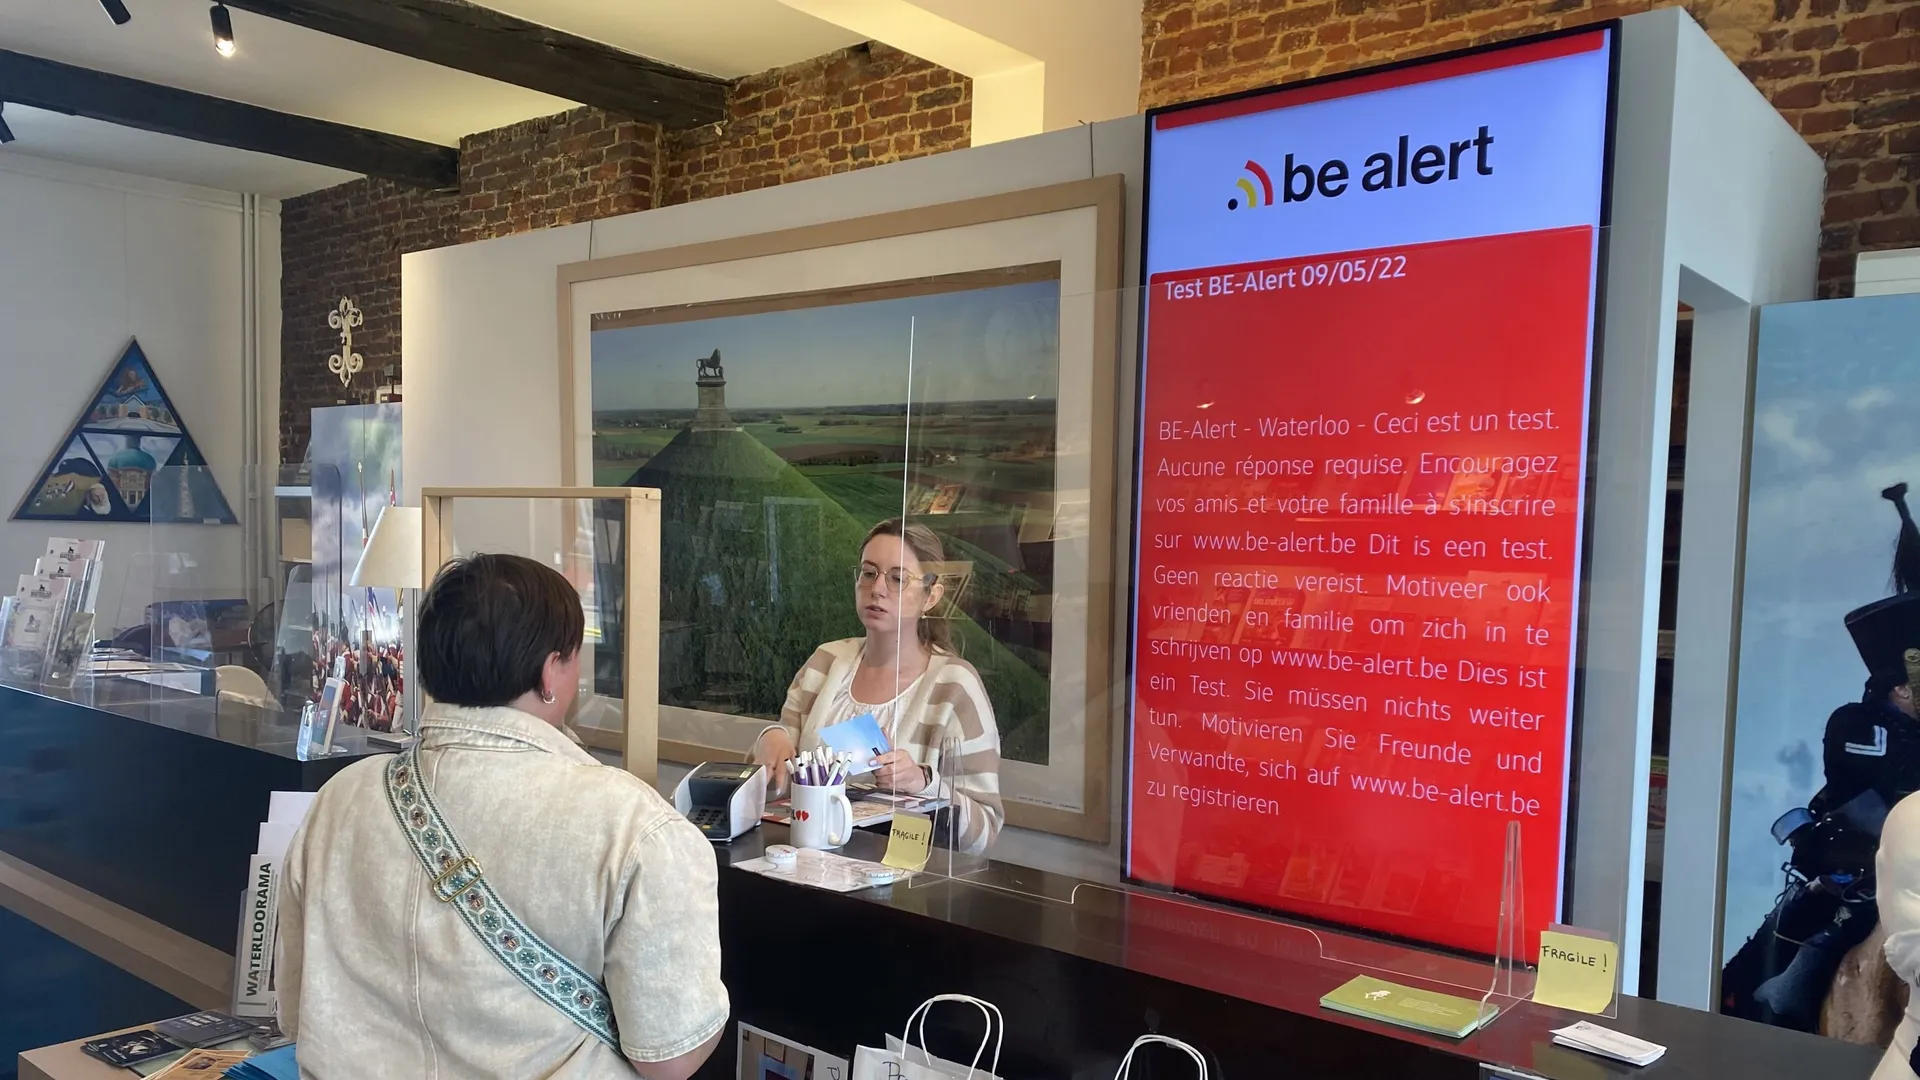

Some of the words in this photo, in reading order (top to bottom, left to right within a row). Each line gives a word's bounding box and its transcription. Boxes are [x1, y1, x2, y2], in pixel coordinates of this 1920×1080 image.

[1284, 153, 1348, 203] be
[1362, 125, 1494, 192] alert
[1165, 279, 1203, 300] Test
[1209, 268, 1296, 297] BE-Alert
[1302, 255, 1406, 287] 09/05/22
[1159, 420, 1236, 440] BE-Alert
[1259, 415, 1349, 437] Waterloo
[1374, 412, 1418, 435] Ceci
[1427, 412, 1461, 432] est
[1470, 413, 1498, 431] un
[1508, 408, 1560, 430] test.
[1157, 458, 1225, 476] Aucune
[1236, 455, 1313, 480] réponse
[1325, 455, 1408, 480] requise.
[1421, 453, 1558, 478] Encouragez
[1156, 498, 1185, 513] vos
[1195, 496, 1238, 514] amis
[1249, 497, 1266, 514] et
[1278, 497, 1328, 514] votre
[1340, 493, 1413, 516] famille
[1425, 493, 1437, 515] à
[1450, 494, 1556, 516] s'inscrire
[1154, 532, 1181, 548] sur
[1193, 530, 1356, 555] www.be-alert.be
[1370, 534, 1400, 555] Dit
[1414, 537, 1430, 556] is
[1444, 540, 1486, 557] een
[1501, 539, 1553, 560] test.
[1154, 565, 1198, 585] Geen
[1214, 568, 1278, 590] reactie
[1295, 572, 1368, 594] vereist.
[1387, 574, 1487, 599] Motiveer
[1507, 581, 1550, 603] ook
[1153, 603, 1230, 624] vrienden
[1245, 609, 1269, 627] en
[1284, 608, 1354, 633] familie
[1370, 618, 1404, 636] om
[1422, 618, 1466, 639] zich
[1486, 621, 1505, 642] in
[1525, 624, 1549, 645] te
[1151, 637, 1231, 663] schrijven
[1239, 646, 1263, 667] op
[1272, 649, 1447, 680] www.be-alert.be
[1459, 660, 1507, 685] Dies
[1520, 665, 1547, 689] ist
[1150, 673, 1176, 691] ein
[1190, 675, 1229, 698] Test.
[1245, 680, 1273, 702] Sie
[1288, 687, 1366, 712] müssen
[1384, 696, 1451, 721] nichts
[1469, 705, 1545, 730] weiter
[1149, 708, 1182, 728] tun.
[1202, 712, 1302, 743] Motivieren
[1325, 727, 1356, 750] Sie
[1379, 733, 1471, 765] Freunde
[1497, 750, 1542, 774] und
[1147, 780, 1166, 797] zu
[1172, 781, 1279, 816] registrieren
[1148, 741, 1249, 778] Verwandte,
[1259, 757, 1297, 781] sich
[1308, 766, 1340, 787] auf
[1351, 772, 1540, 816] www.be-alert.be
[246, 862, 272, 997] WATERLOORAMA
